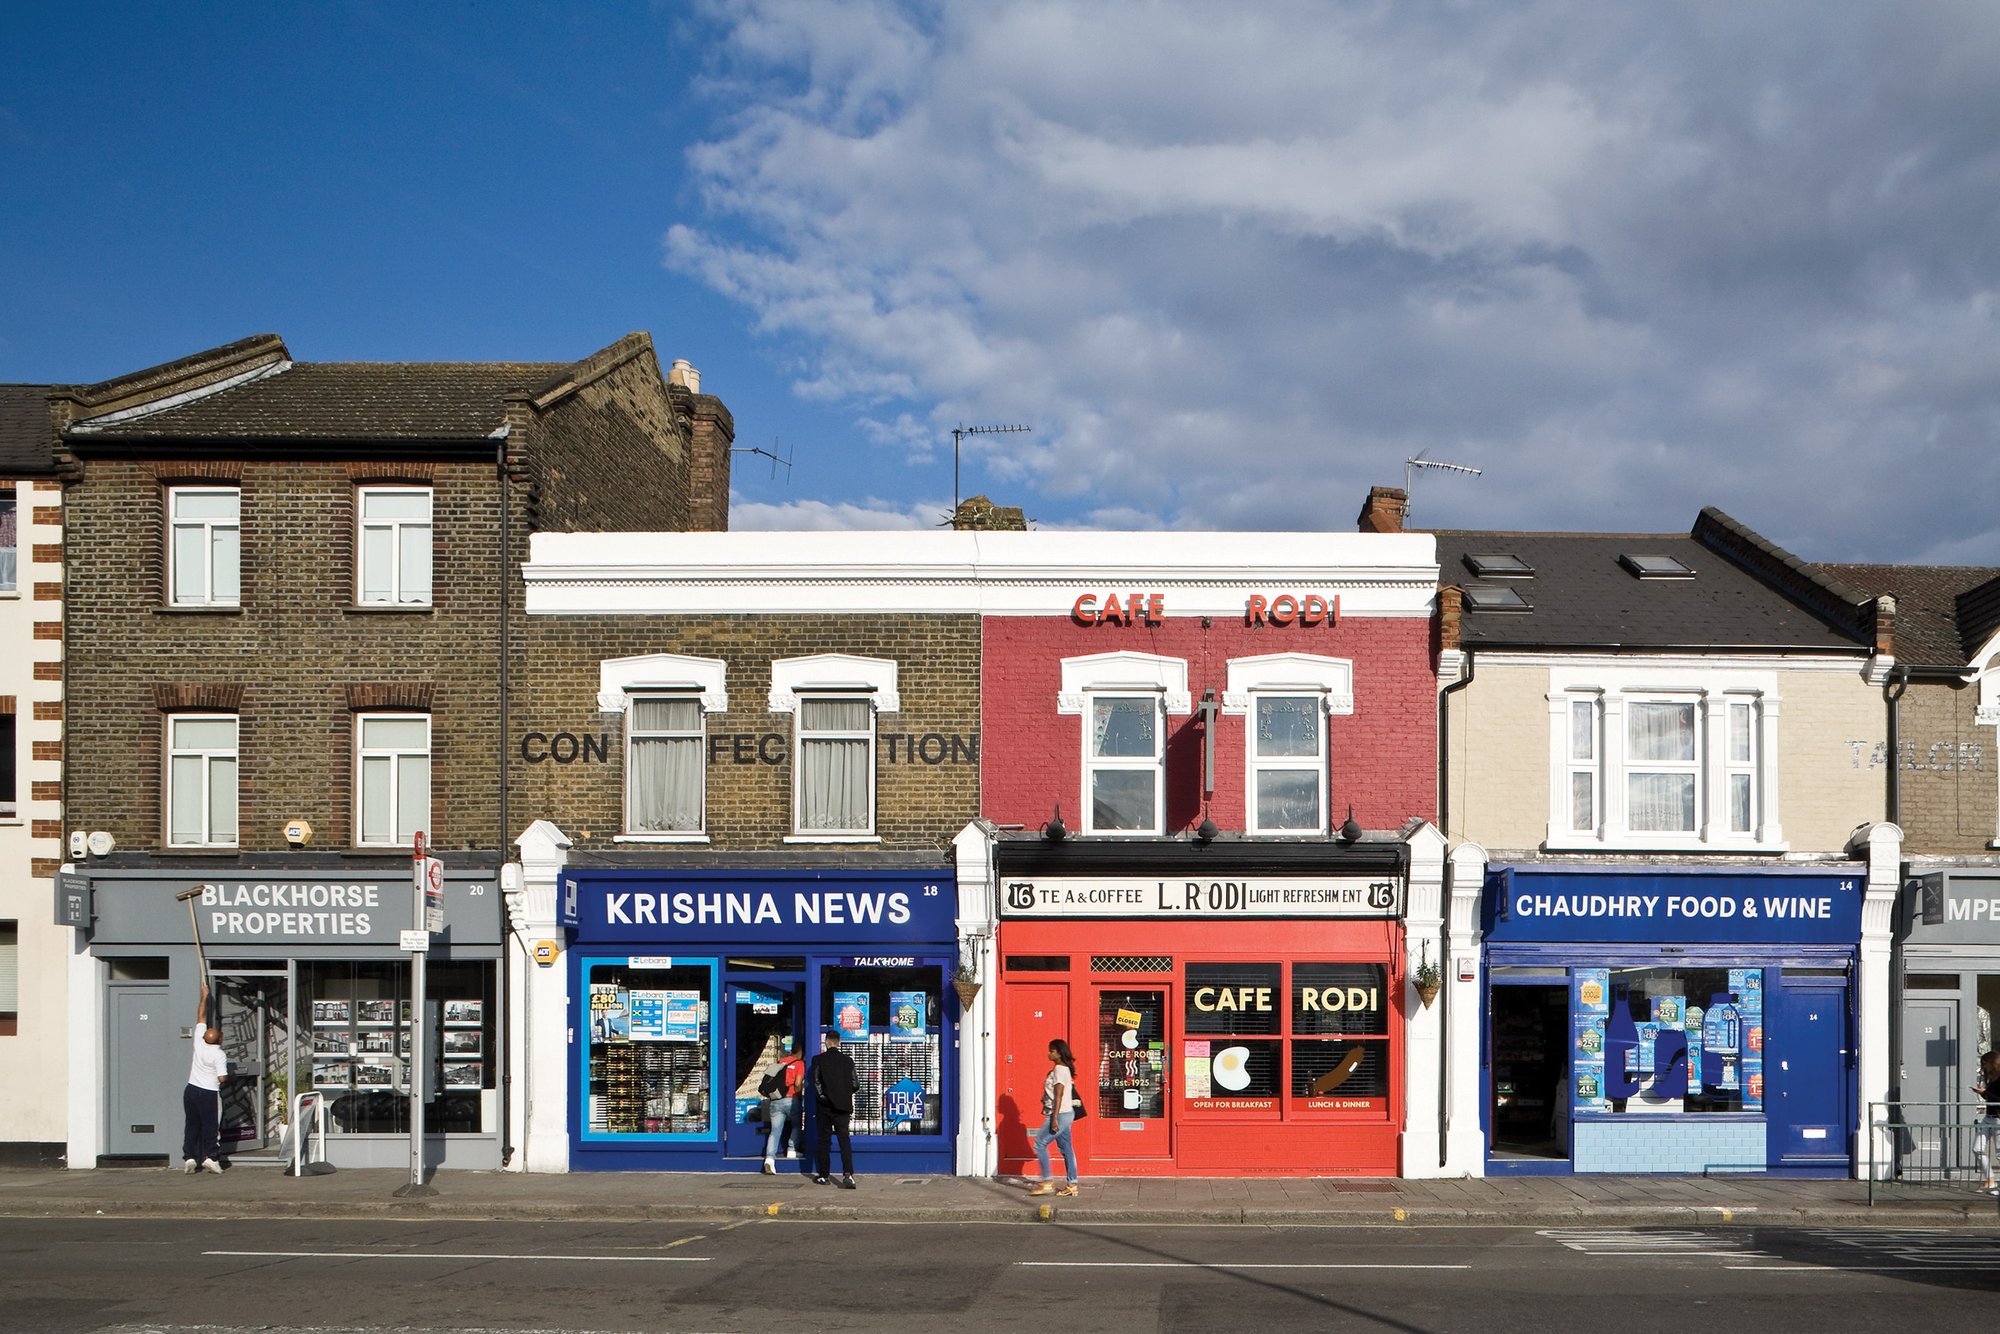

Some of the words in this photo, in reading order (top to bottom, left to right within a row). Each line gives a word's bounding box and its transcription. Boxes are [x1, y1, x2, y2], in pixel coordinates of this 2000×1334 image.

[1073, 593, 1165, 622] CAFE
[1249, 594, 1340, 622] RODI
[520, 732, 609, 764] CON
[709, 733, 786, 765] FEC
[880, 733, 977, 765] TION
[469, 885, 484, 896] 20
[923, 885, 938, 897] 18
[1839, 881, 1853, 891] 14
[202, 884, 379, 907] BLACKHORSE
[1013, 887, 1031, 906] 16
[1249, 890, 1280, 903] LIGHT
[1373, 887, 1392, 906] 16
[606, 893, 782, 925] KRISHNA
[795, 893, 911, 925] NEWS
[1516, 895, 1660, 918] CHAUDHRY
[1666, 896, 1737, 918] FOOD
[1742, 896, 1759, 918] &
[1765, 897, 1832, 919] WINE
[1948, 898, 2000, 921] MPE
[212, 912, 371, 935] PROPERTIES
[537, 948, 550, 956] ADT
[640, 957, 667, 965] Lebara
[853, 957, 881, 966] TALK
[884, 957, 914, 966] HOME
[591, 994, 616, 1003] £80
[637, 991, 664, 999] Lebara
[672, 991, 698, 999] Lebara
[1193, 987, 1272, 1011] CAFE
[1302, 987, 1377, 1011] RODI
[1118, 1016, 1139, 1025] CLOSED
[1109, 1050, 1131, 1058] CAFE
[890, 1092, 922, 1104] TALK
[889, 1103, 923, 1116] HOME
